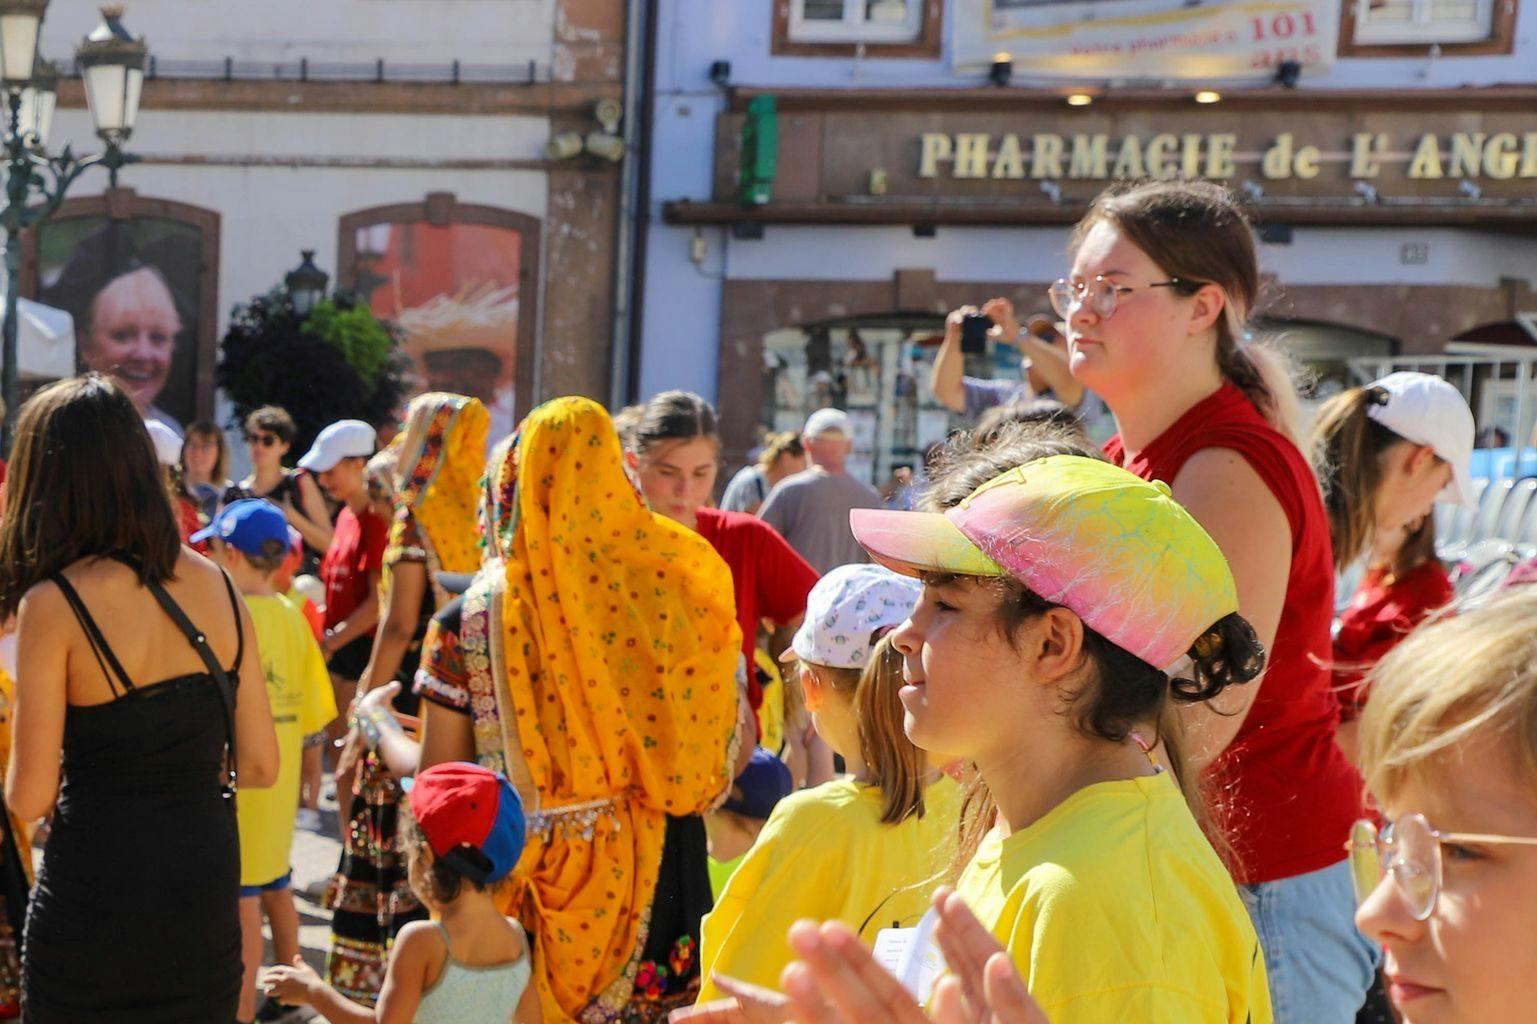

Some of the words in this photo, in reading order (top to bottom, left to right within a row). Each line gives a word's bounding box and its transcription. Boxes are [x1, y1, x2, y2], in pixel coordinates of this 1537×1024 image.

[1250, 12, 1318, 41] 101
[1250, 45, 1321, 70] ans
[919, 132, 1237, 179] PHARMACIE
[1262, 132, 1320, 180] de
[1350, 132, 1390, 179] L'
